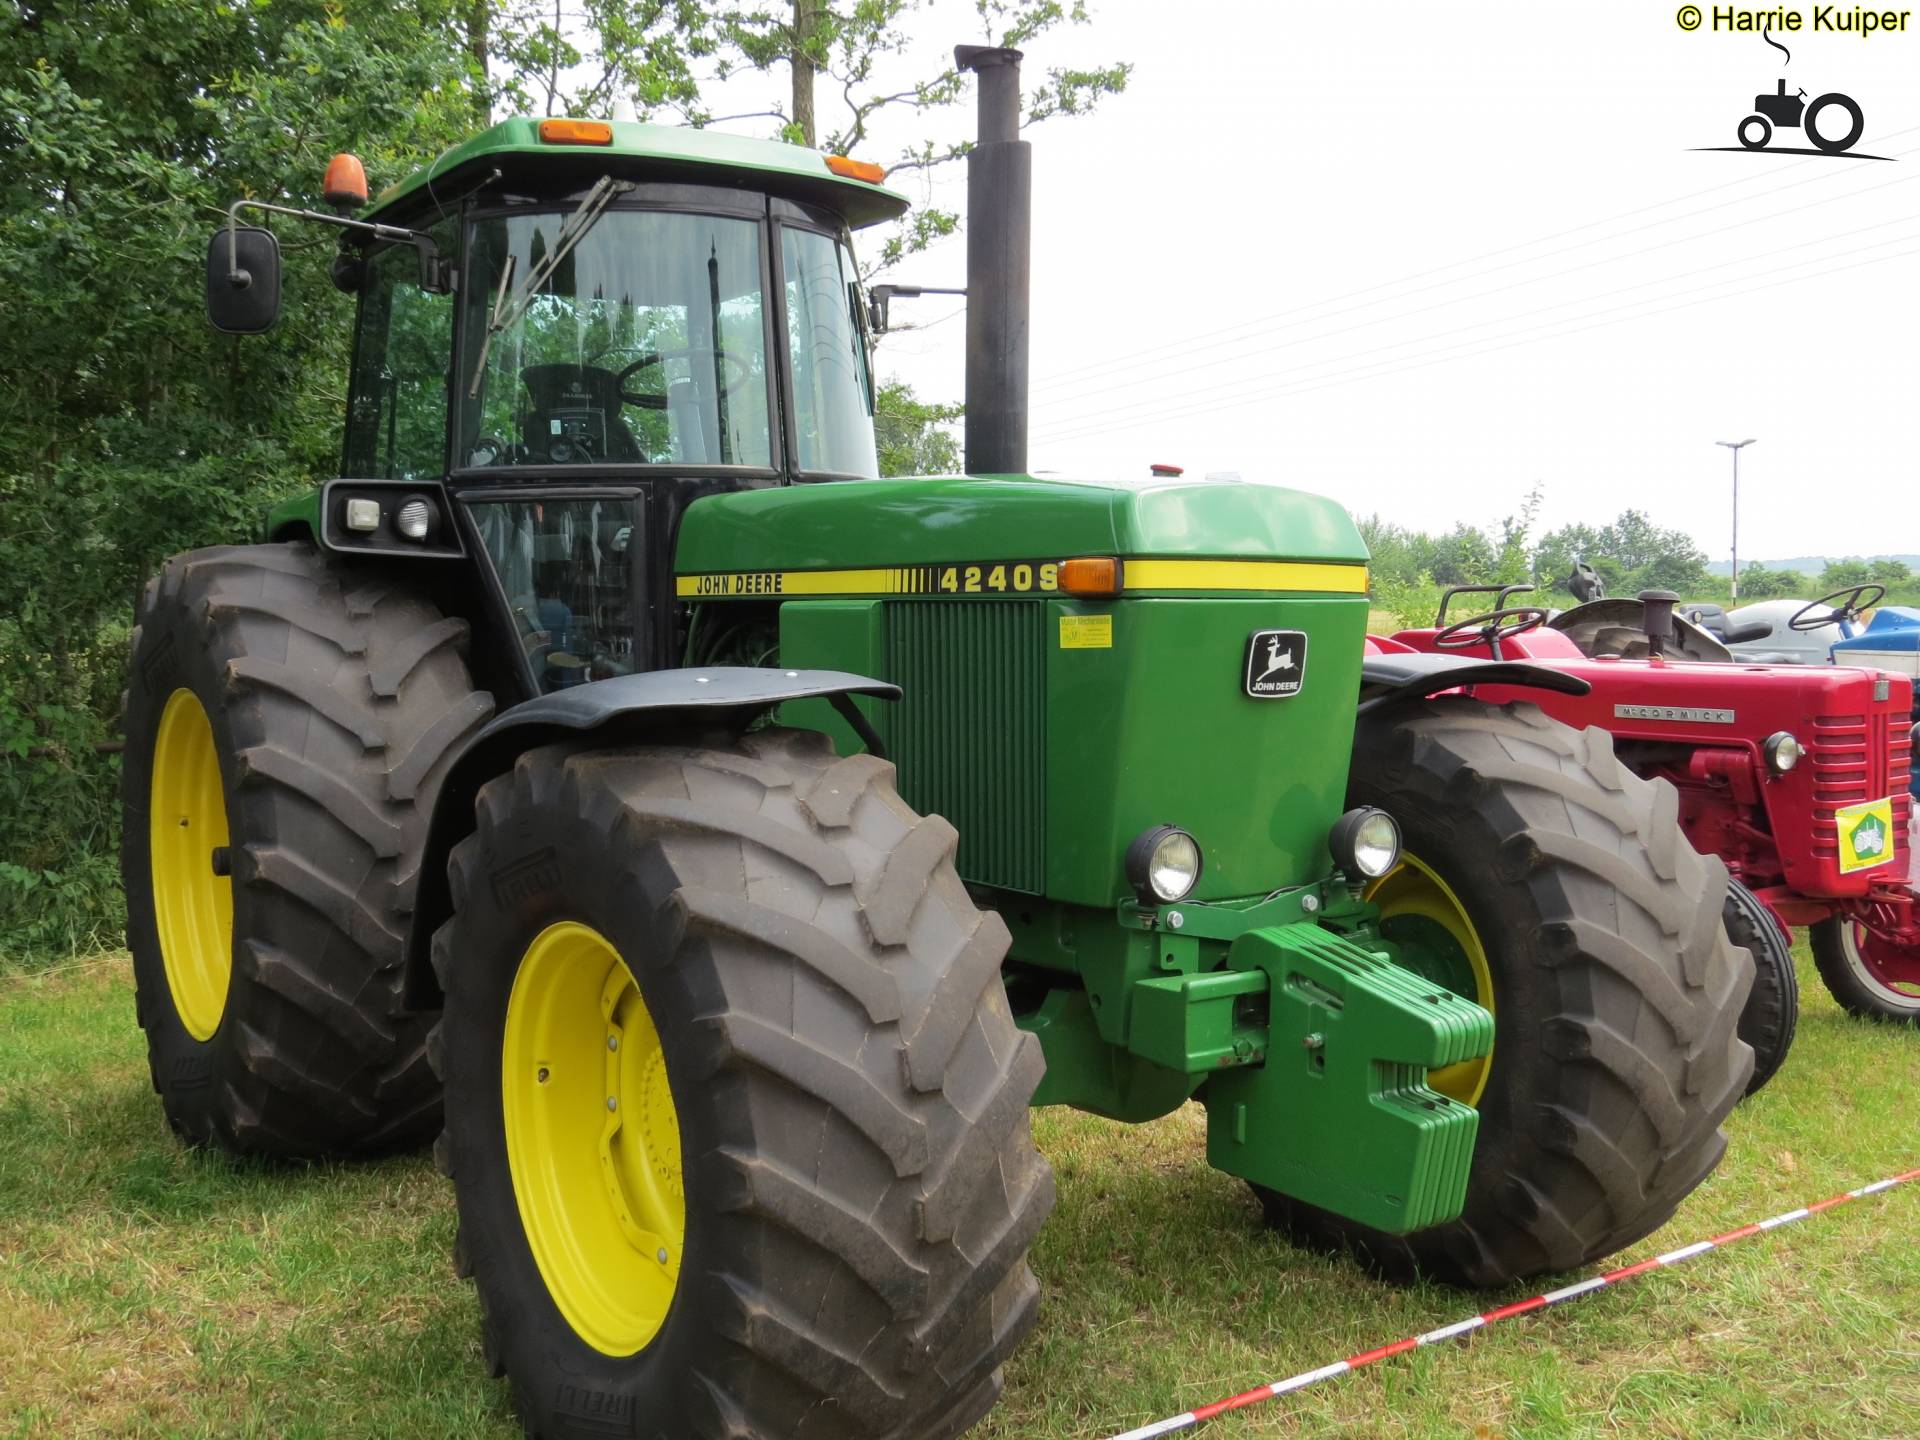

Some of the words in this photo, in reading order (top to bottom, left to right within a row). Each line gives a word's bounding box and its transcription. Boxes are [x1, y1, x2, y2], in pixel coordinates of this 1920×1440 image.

[697, 576, 729, 594] JOHN
[736, 574, 782, 593] DEERE
[941, 564, 1059, 593] 4240S
[1252, 682, 1275, 691] JOHN
[1276, 681, 1299, 691] DEERE
